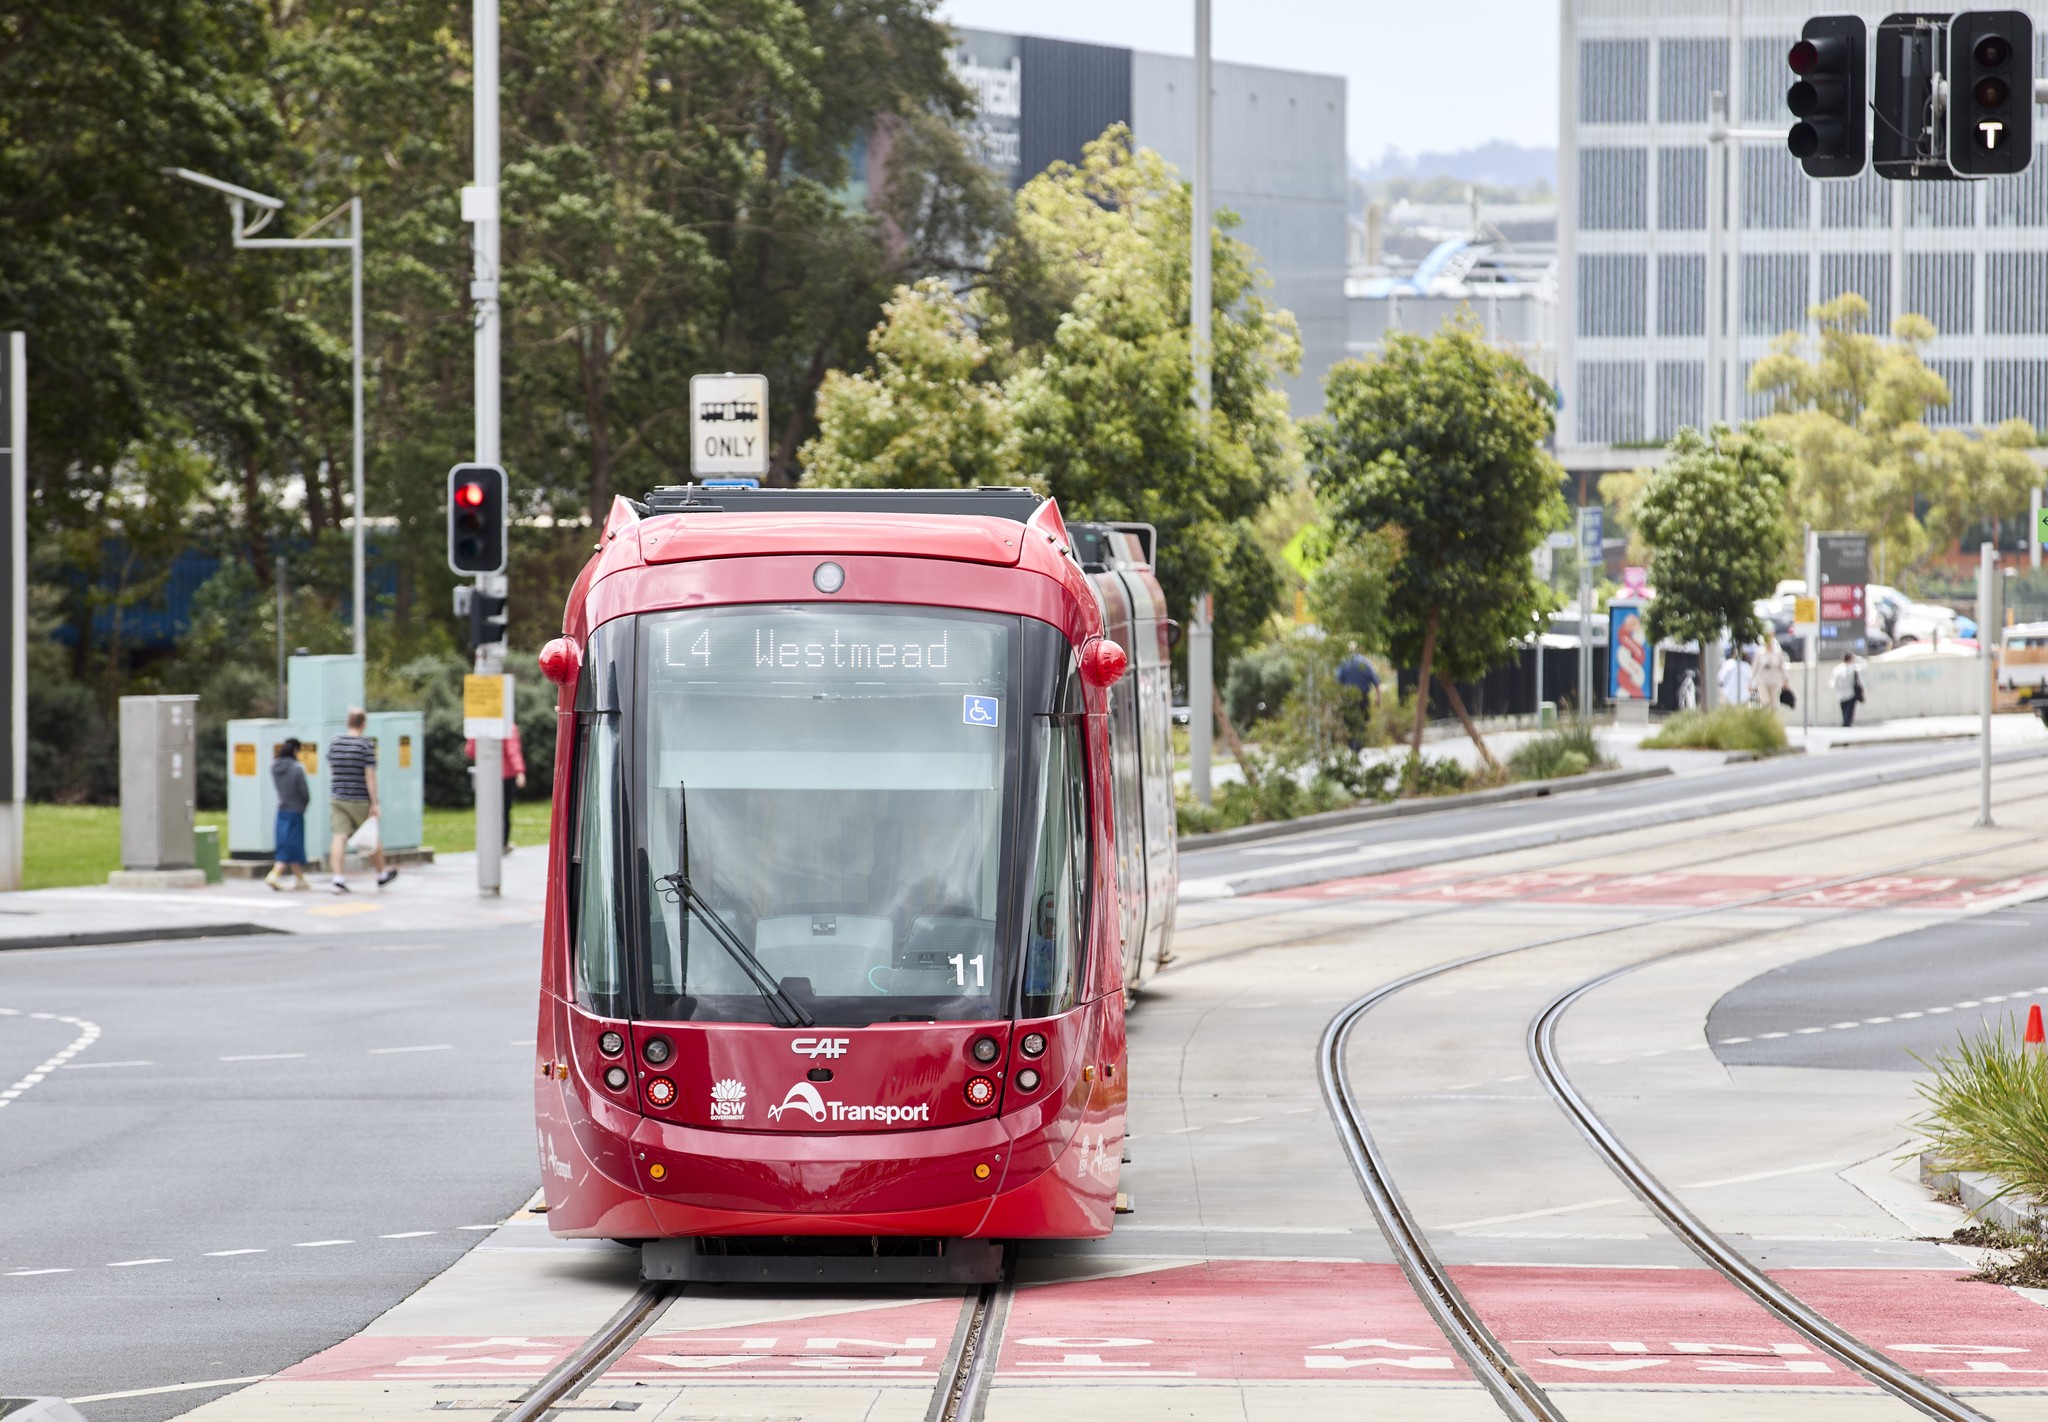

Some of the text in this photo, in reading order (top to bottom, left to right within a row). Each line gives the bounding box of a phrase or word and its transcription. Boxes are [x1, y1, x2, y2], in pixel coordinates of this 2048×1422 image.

[705, 436, 756, 457] ONLY
[665, 628, 948, 668] L4 Westmead
[949, 953, 984, 987] 11
[791, 1038, 850, 1059] CAF
[710, 1102, 746, 1115] NSW
[827, 1101, 929, 1124] Transport
[433, 1337, 1156, 1349] ONLY
[1307, 1338, 2032, 1354] ONLY
[395, 1355, 1152, 1368] TRAM
